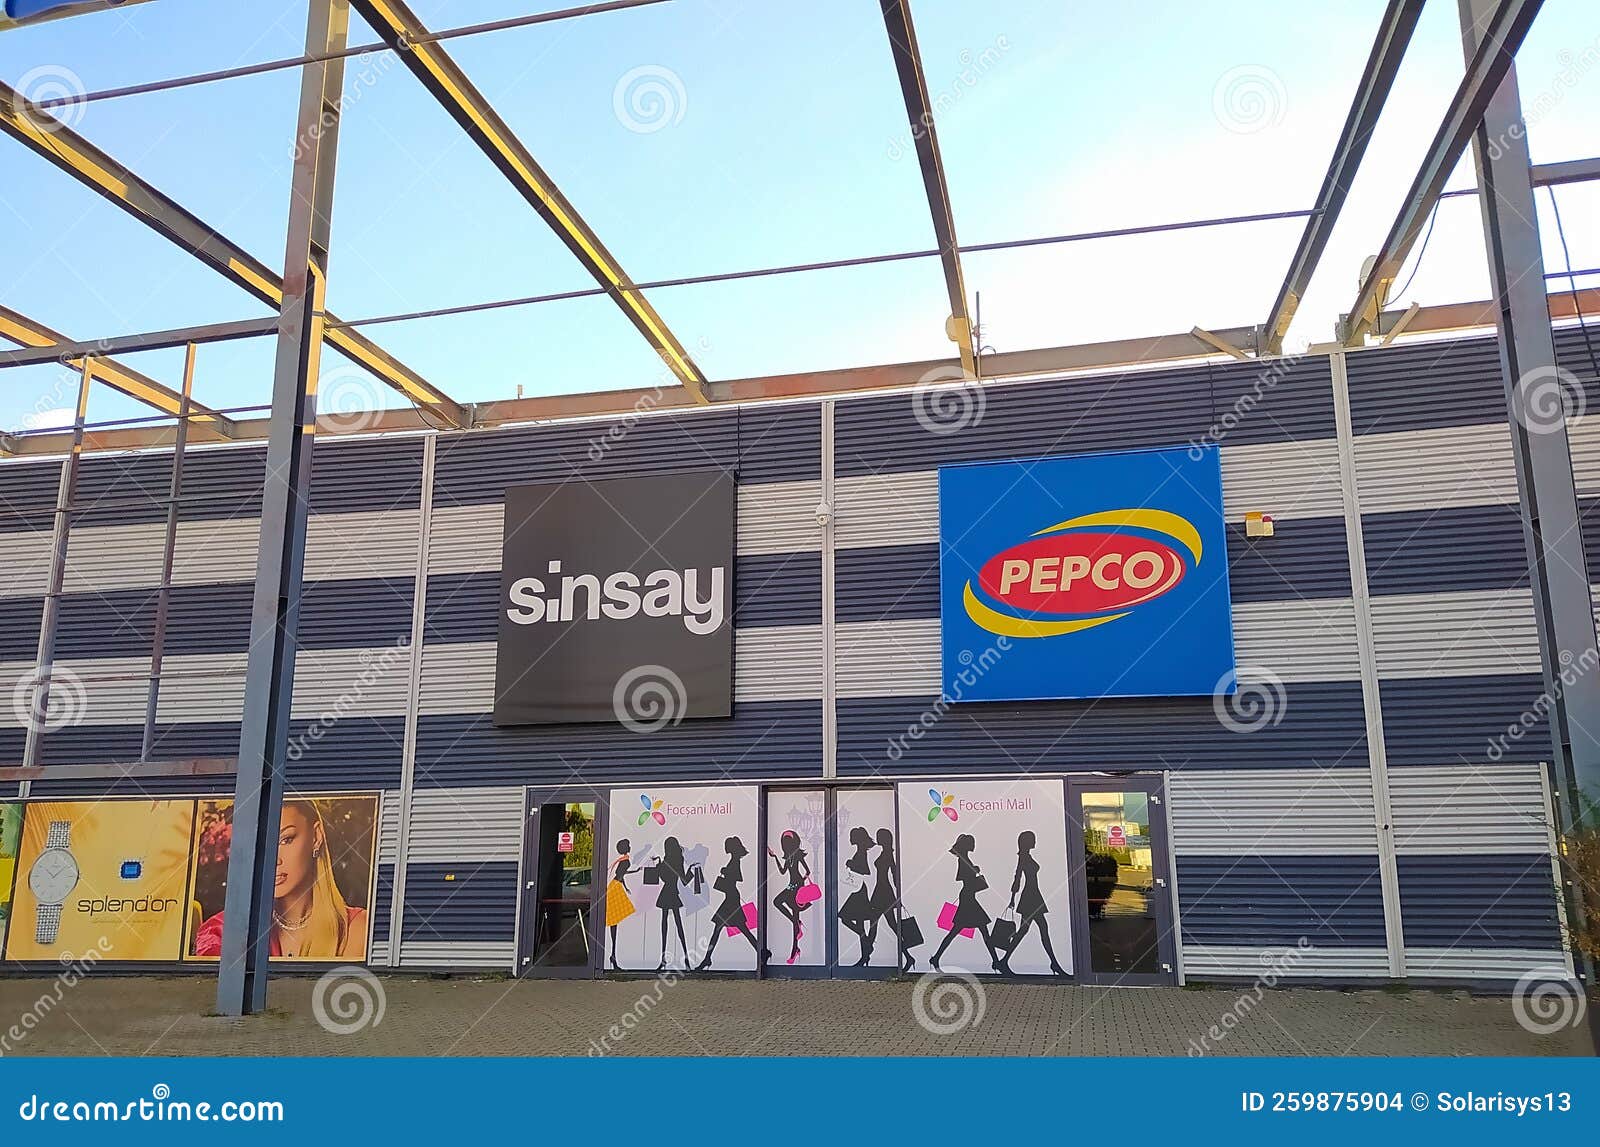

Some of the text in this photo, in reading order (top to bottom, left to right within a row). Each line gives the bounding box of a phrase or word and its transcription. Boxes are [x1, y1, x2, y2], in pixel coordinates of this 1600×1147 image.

[1000, 551, 1164, 595] PEPCO
[507, 560, 724, 635] sinsay
[709, 802, 732, 814] Mall
[1006, 797, 1032, 810] Mall
[77, 895, 178, 916] splend'or
